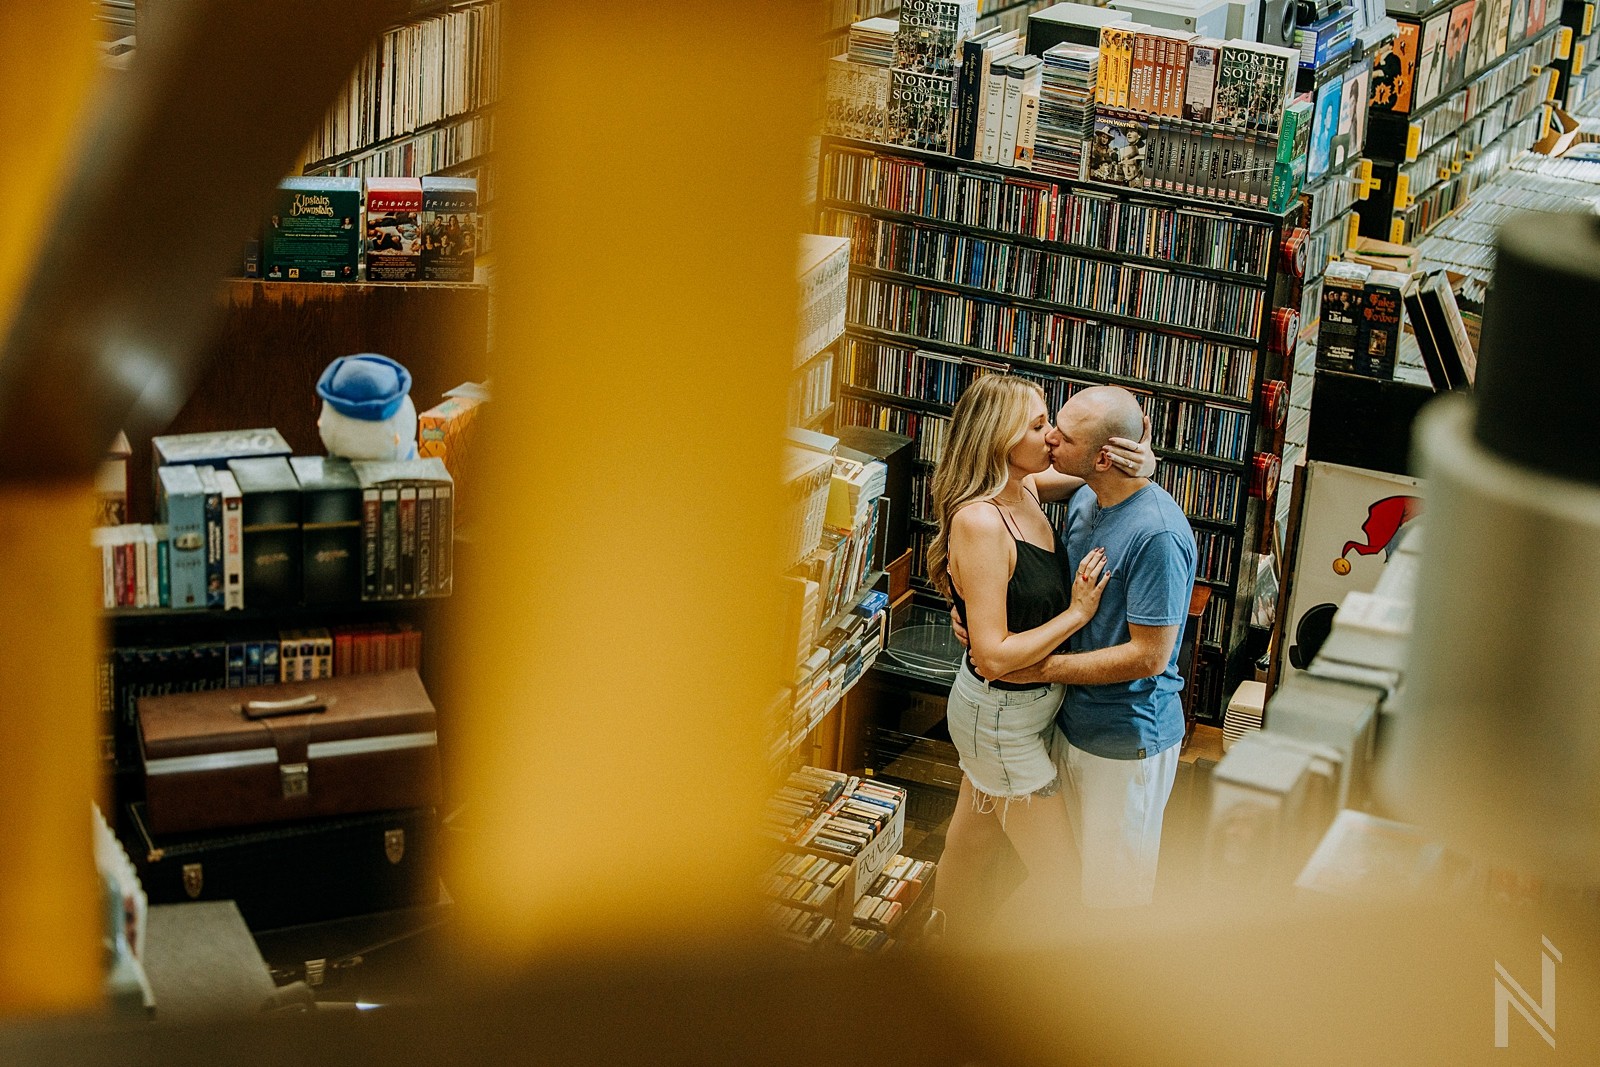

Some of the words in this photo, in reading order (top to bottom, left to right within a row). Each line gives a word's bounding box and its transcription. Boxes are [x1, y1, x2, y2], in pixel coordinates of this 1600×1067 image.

[903, 0, 958, 16] NORTH
[902, 13, 956, 31] SOUTH
[1224, 50, 1285, 70] NORTH
[893, 73, 950, 93] NORTH
[1223, 67, 1283, 87] SOUTH
[893, 89, 948, 108] SOUTH
[912, 87, 930, 95] AND
[1096, 117, 1113, 125] JOHN
[1113, 118, 1136, 129] WAYNE
[1272, 175, 1280, 202] IRELAND
[295, 194, 330, 207] Upstairs
[371, 200, 419, 208] FRIENDS
[425, 200, 473, 208] FRIENDS
[289, 202, 334, 217] Downstairs
